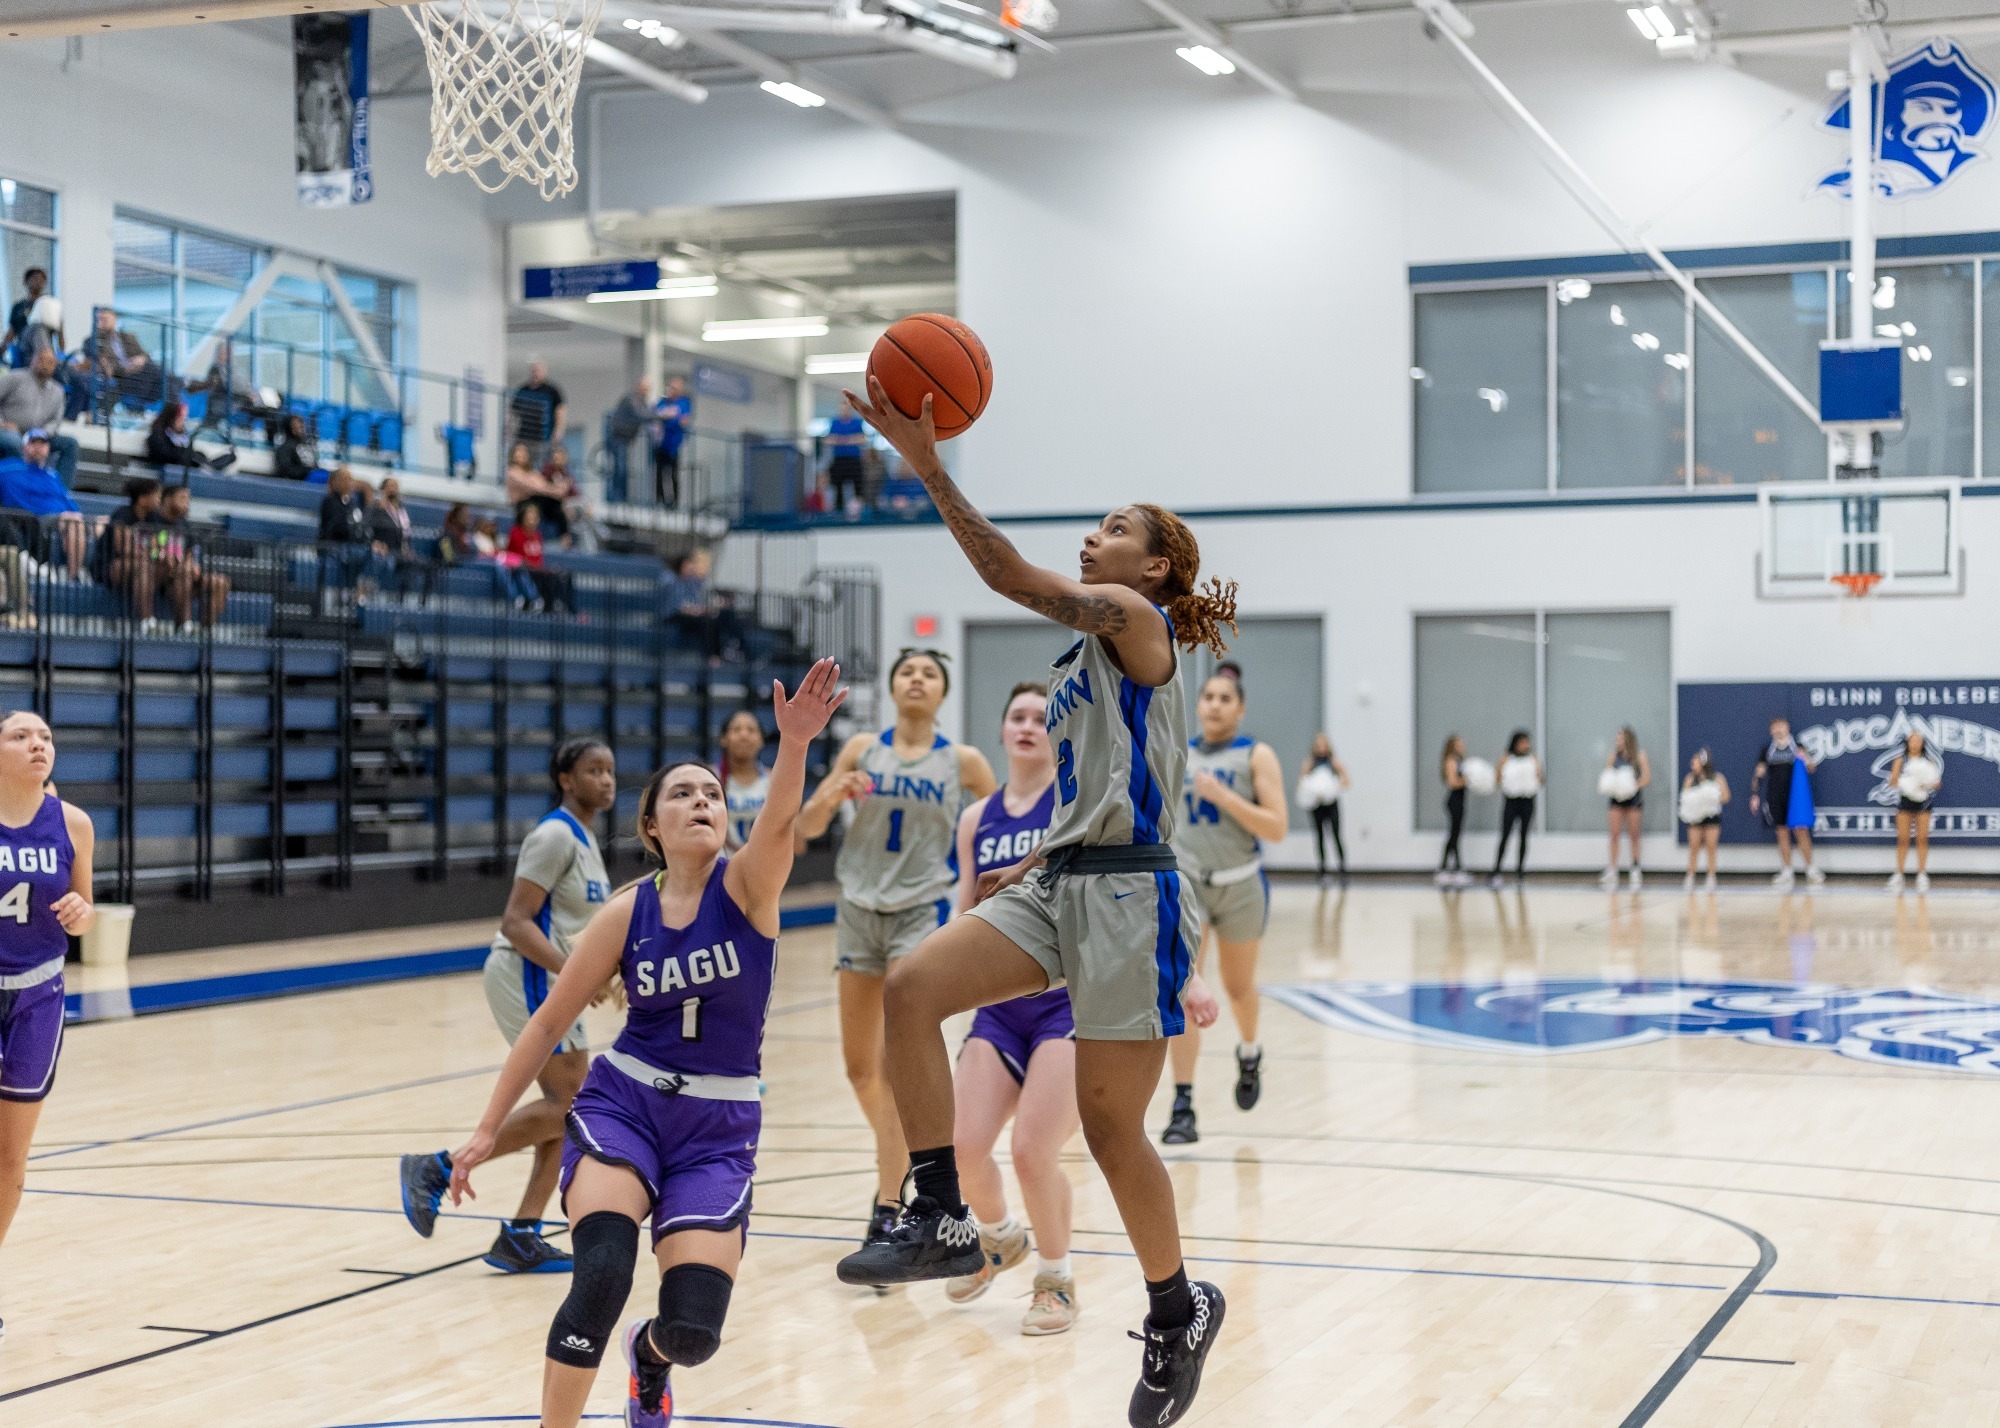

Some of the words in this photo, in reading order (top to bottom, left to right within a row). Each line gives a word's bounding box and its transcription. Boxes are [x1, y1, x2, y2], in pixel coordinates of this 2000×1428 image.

[1810, 687, 1882, 706] BLINN
[1895, 686, 2000, 705] COLLEGE
[866, 770, 945, 805] LINN
[1057, 737, 1078, 808] 2
[886, 807, 904, 853] 1
[636, 940, 741, 997] SAGU
[681, 996, 702, 1040] 1
